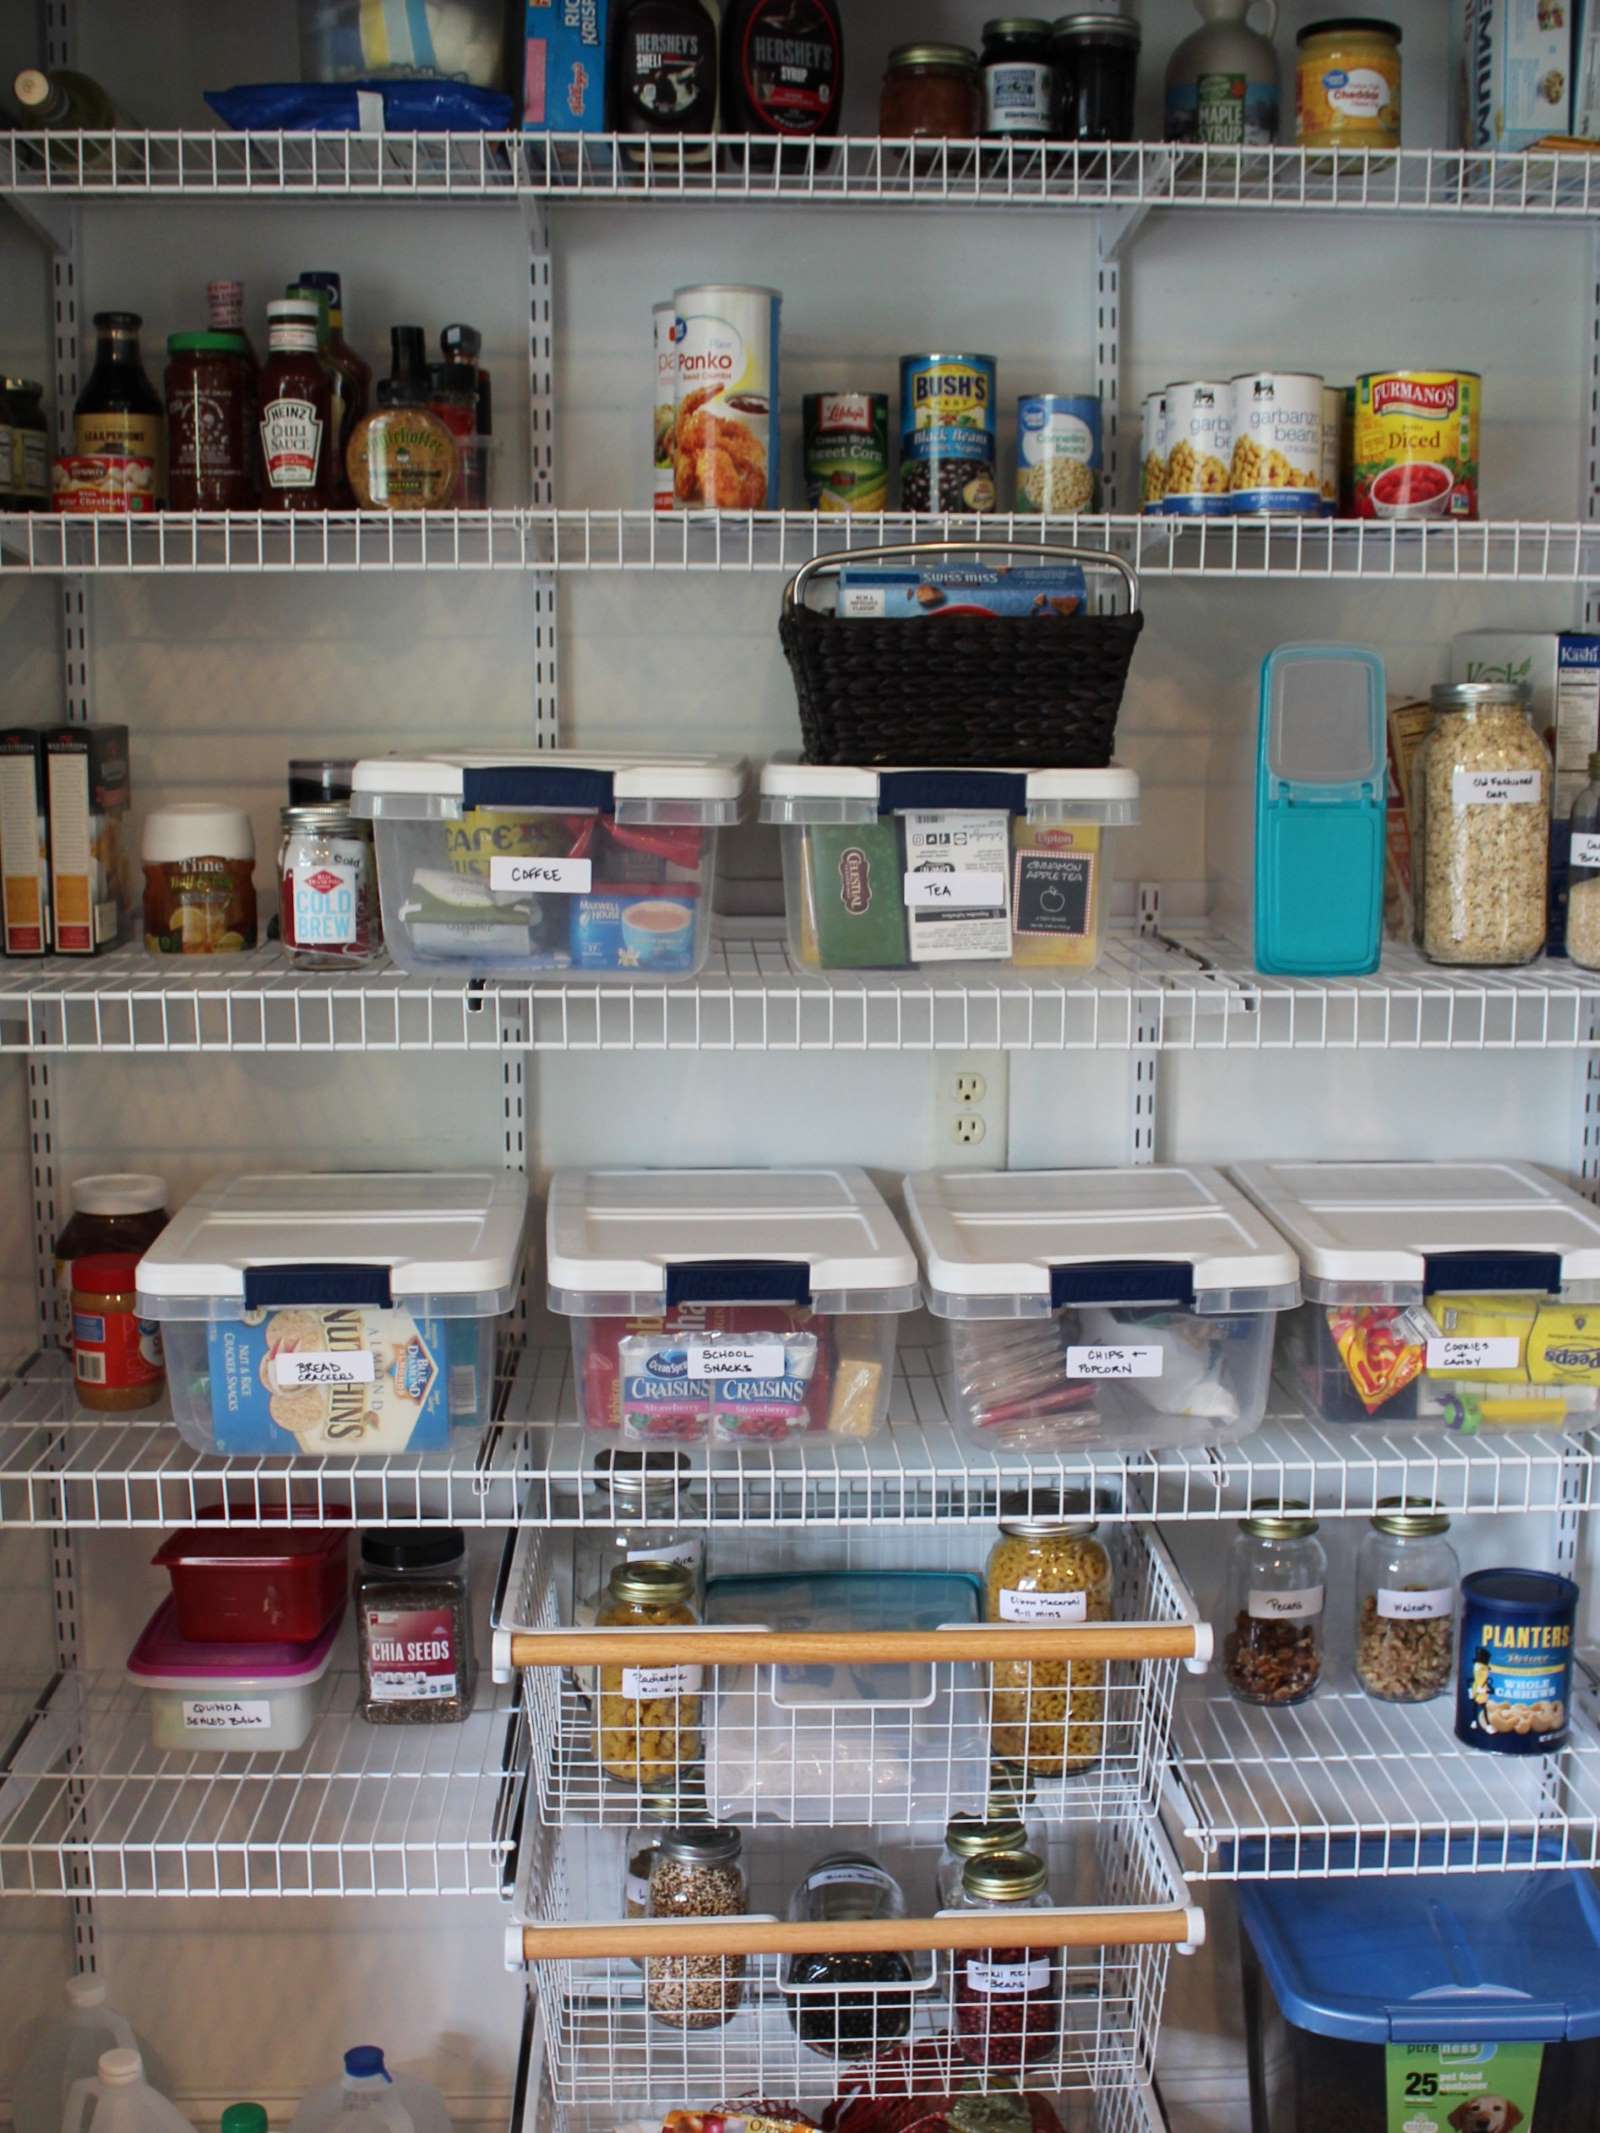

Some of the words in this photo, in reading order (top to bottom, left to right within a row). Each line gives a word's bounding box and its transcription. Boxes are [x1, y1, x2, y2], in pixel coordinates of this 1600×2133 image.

[635, 33, 698, 55] HERSHEY'S
[754, 36, 832, 71] HERSHEY'S
[1199, 105, 1243, 124] MAPLE
[678, 351, 733, 371] Panko
[915, 375, 986, 401] BUSH'S
[1373, 380, 1456, 409] FURMANO'S
[271, 406, 307, 420] HEINZ
[271, 423, 307, 438] CHILI
[271, 437, 310, 451] SAUCE
[1388, 431, 1441, 449] Diced
[850, 445, 883, 463] Corn
[1560, 645, 1598, 665] Kashi
[1036, 832, 1073, 846] Lipton
[178, 857, 224, 873] Time
[333, 853, 361, 868] Cold
[1026, 861, 1082, 872] CINNAMON
[510, 867, 562, 882] COFFEE
[847, 851, 863, 909] CELESTIAL
[1025, 871, 1059, 881] APPLE
[1061, 872, 1083, 882] TEA
[924, 885, 951, 897] TEA
[296, 890, 351, 913] COLD
[298, 915, 350, 938] BREW
[239, 1345, 249, 1365] NUT
[702, 1349, 754, 1360] SCHOOL
[1088, 1350, 1124, 1361] CHIPS
[1444, 1342, 1489, 1352] COOKIES
[1443, 1358, 1481, 1367] CANDY
[1543, 1345, 1600, 1369] Peeps
[296, 1362, 341, 1374] BREAD
[368, 1327, 385, 1411] ALMOND
[407, 1345, 421, 1399] DIAMOND
[416, 1357, 429, 1388] BLUE
[703, 1363, 753, 1374] SNACKS
[1078, 1363, 1132, 1375] POPCORN
[227, 1376, 238, 1412] SNACKS
[631, 1378, 711, 1399] CRAISINS
[722, 1378, 803, 1401] CRAISINS
[644, 1403, 699, 1413] Strawberry
[735, 1405, 790, 1416] Strawberry
[1266, 1598, 1303, 1611] Pecans
[1481, 1624, 1571, 1648] PLANTERS
[372, 1641, 405, 1662] CHIA
[407, 1640, 449, 1662] SEEDS
[1503, 1678, 1550, 1690] WHOLE
[1494, 1687, 1557, 1700] CASHEWS
[193, 1703, 242, 1713] QUINOA
[1404, 2071, 1439, 2096] 25
